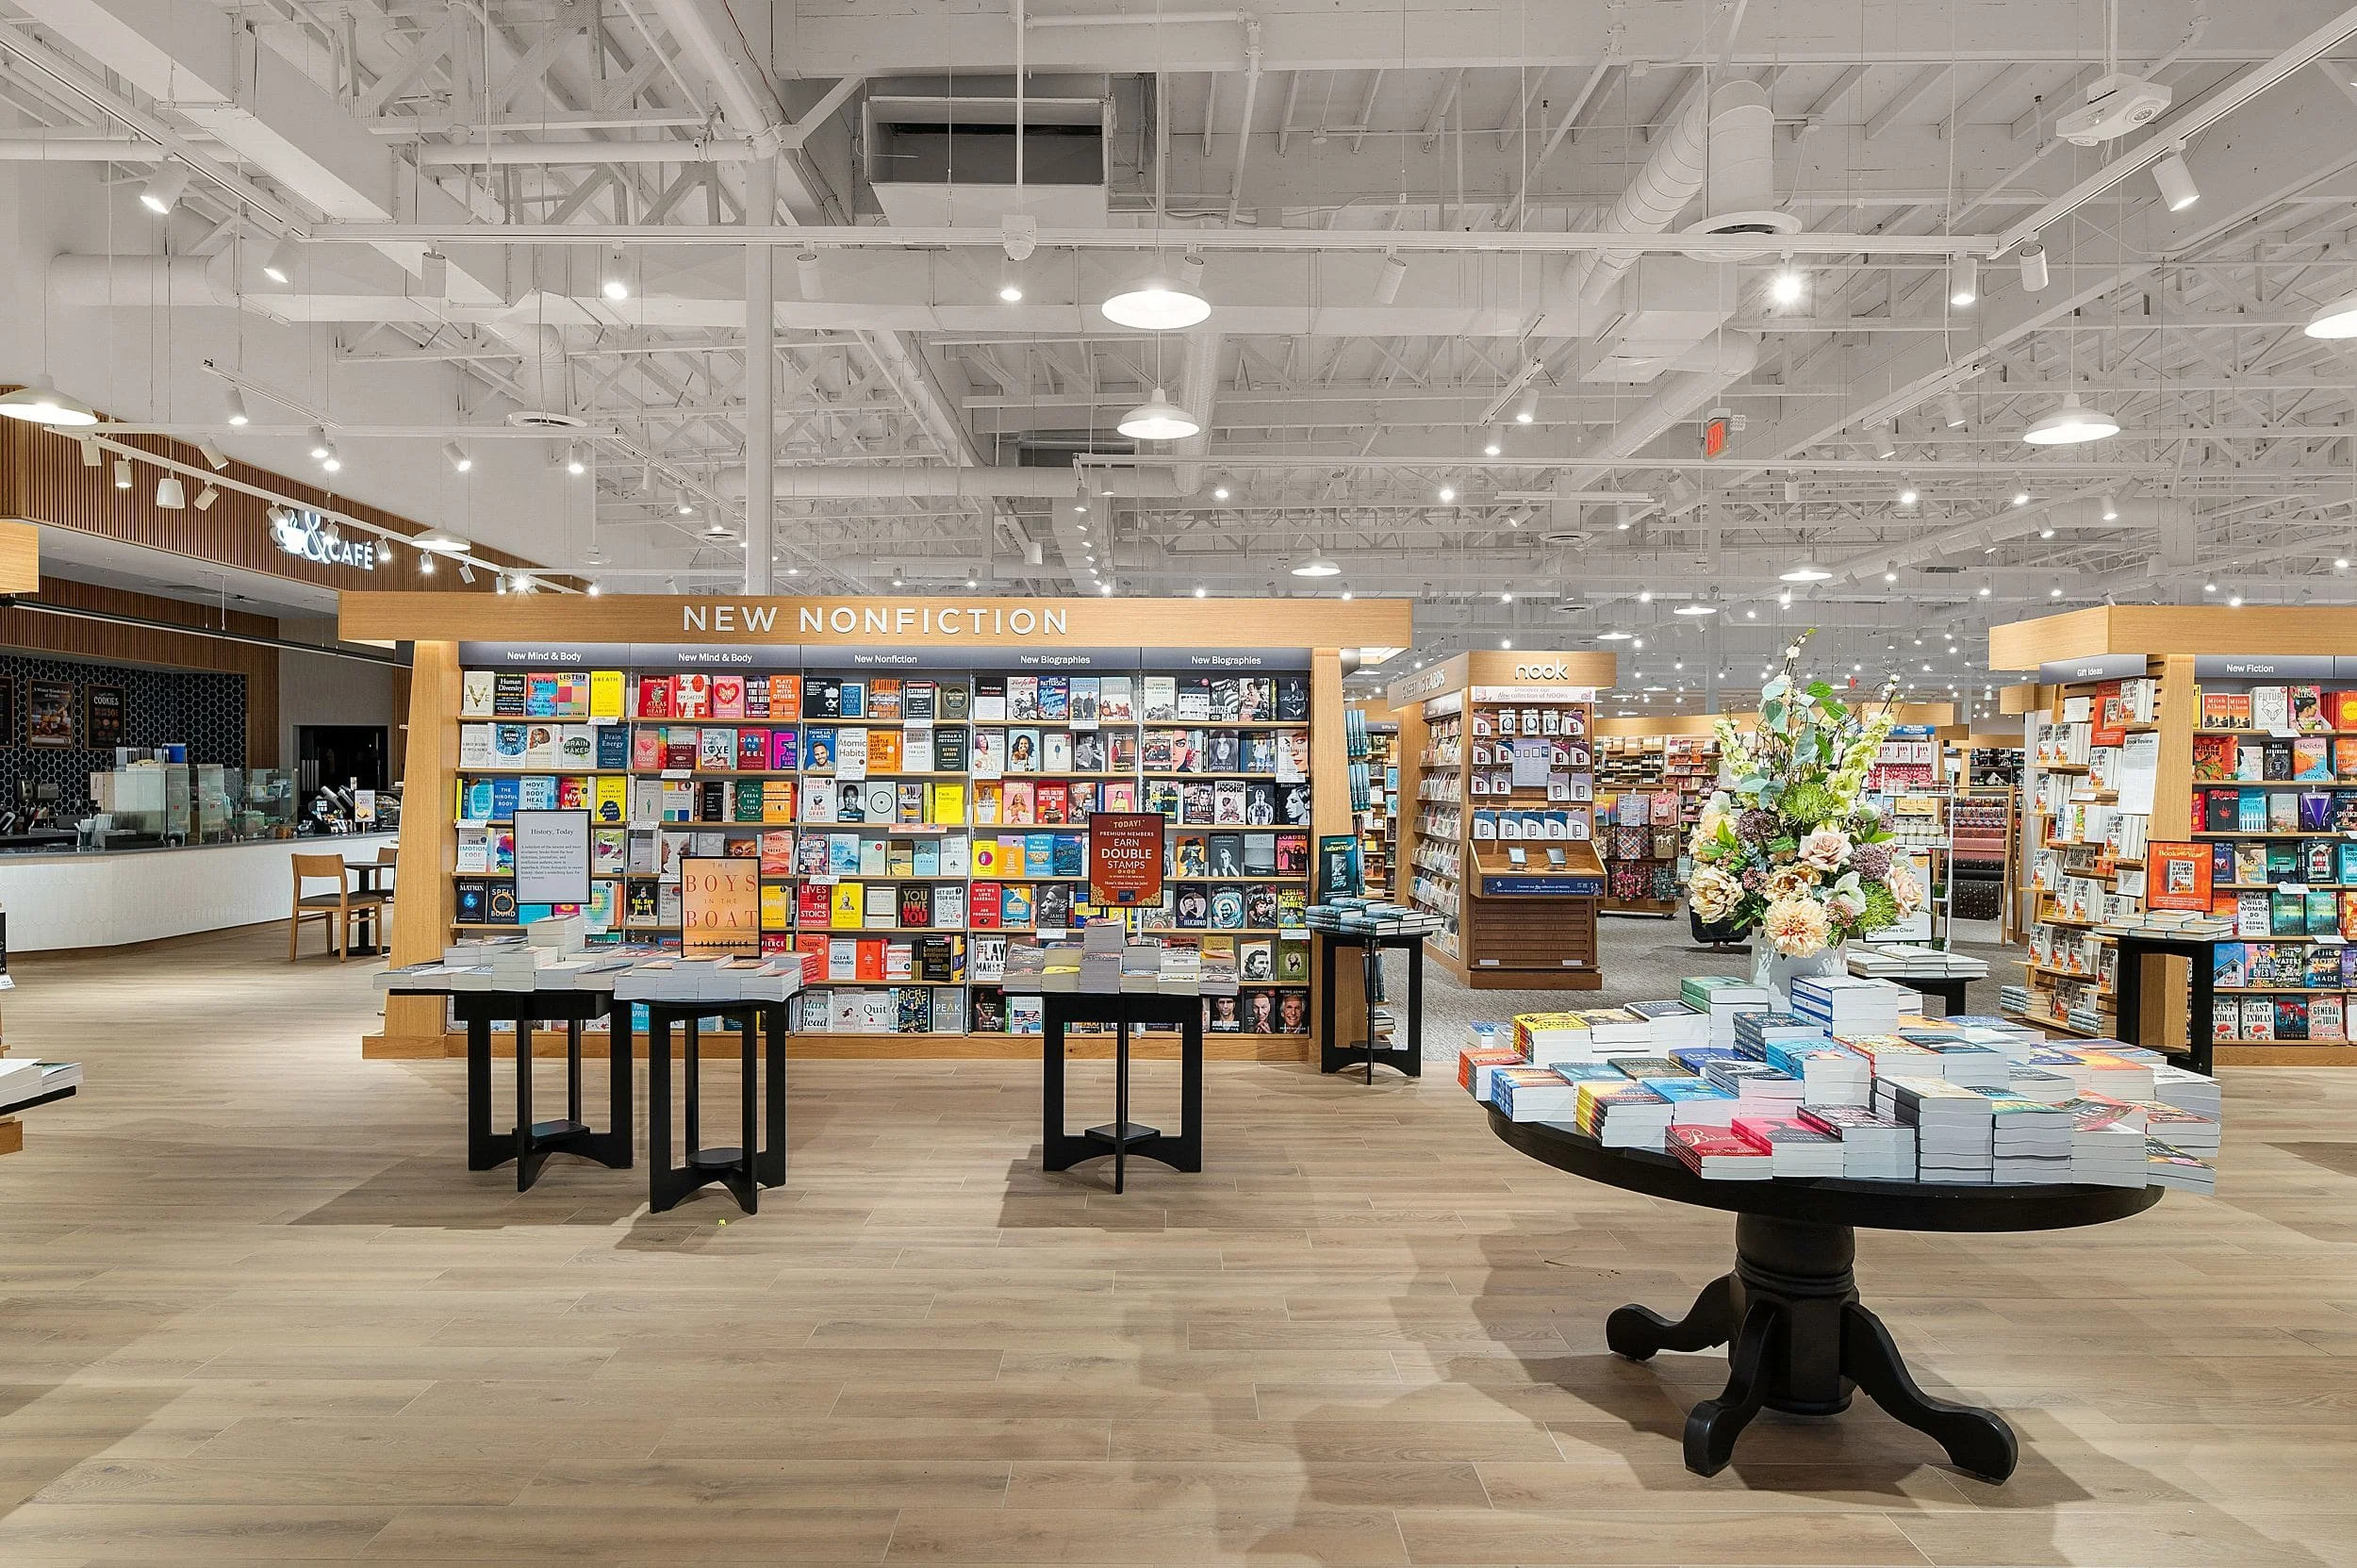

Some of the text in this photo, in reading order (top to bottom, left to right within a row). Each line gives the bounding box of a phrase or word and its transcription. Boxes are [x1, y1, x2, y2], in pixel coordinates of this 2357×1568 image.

[684, 605, 1067, 635] NEW NONFICTION
[507, 652, 582, 663] New Mind & Body
[678, 652, 752, 664] New Mind & Body
[854, 654, 917, 664] New Nonfiction
[1020, 655, 1091, 666] New Biographies
[1192, 655, 1261, 666] New Biographies
[1515, 658, 1568, 680] nook
[2077, 668, 2102, 677] Gift Ideas
[2226, 664, 2274, 672] New Fiction
[498, 685, 523, 693] Diversity
[94, 697, 119, 706] COOKIES
[2258, 692, 2286, 701] FUTURE
[1221, 714, 1239, 722] CASH
[602, 740, 624, 749] Energy
[703, 746, 729, 754] LOVE
[838, 749, 865, 757] Habits
[1895, 744, 1908, 758] joy
[1916, 744, 1928, 758] joy
[1114, 838, 1140, 847] EARN
[1101, 849, 1152, 859] DOUBLE
[1108, 861, 1146, 869] STAMPS
[685, 874, 757, 892] BOYS
[801, 885, 826, 894] LIVES
[902, 891, 928, 901] YOU
[902, 901, 928, 911] OWE
[685, 911, 758, 928] BOAT
[902, 912, 928, 923] YOU
[976, 962, 1006, 972] MAKERS
[899, 991, 921, 1004] RICH
[915, 994, 927, 1006] AF
[804, 1000, 828, 1010] dare
[863, 1004, 887, 1015] Quit
[935, 1003, 961, 1012] PEAK
[804, 1009, 815, 1017] to
[2313, 1007, 2339, 1015] GENERAL
[803, 1017, 828, 1027] lead
[2246, 1014, 2272, 1022] INDIAN
[2323, 1016, 2338, 1025] JULIA
[1685, 1130, 1745, 1147] Beloved
